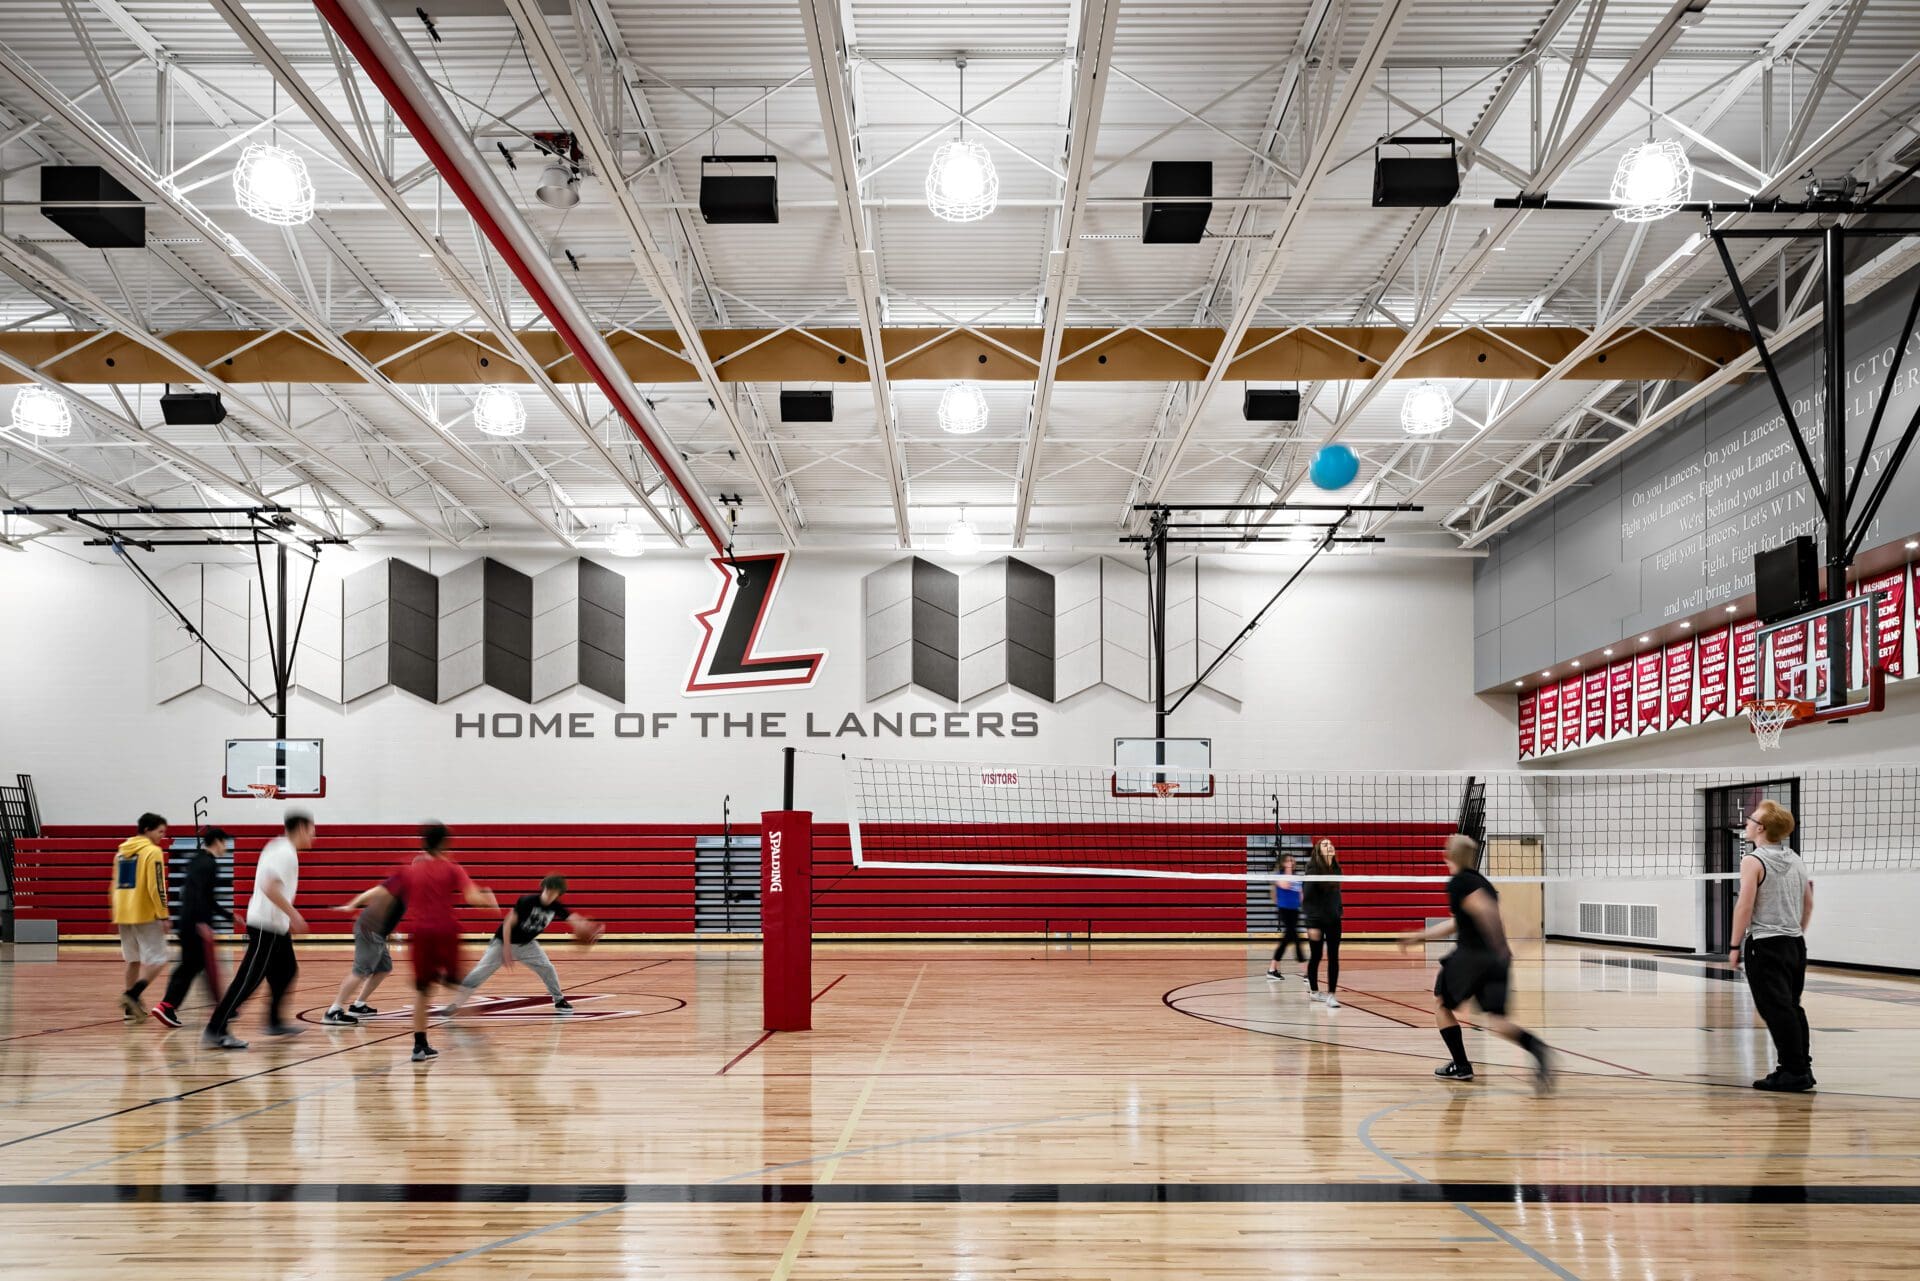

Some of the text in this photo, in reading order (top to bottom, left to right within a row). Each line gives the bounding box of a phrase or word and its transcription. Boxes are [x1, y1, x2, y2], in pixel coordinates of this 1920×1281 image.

[1632, 492, 1645, 508] On
[1647, 483, 1662, 504] you
[1703, 451, 1719, 468] On
[1721, 439, 1740, 463] you
[1792, 399, 1811, 418] On
[1846, 330, 1920, 390] ICTO
[1621, 518, 1641, 539] Fight
[1643, 511, 1658, 531] you
[1699, 474, 1723, 498] Fight
[1726, 464, 1745, 488] you
[1800, 419, 1825, 445] Figh
[1855, 367, 1920, 417] LIER
[1680, 512, 1705, 533] We're
[1706, 490, 1740, 521] behind
[1743, 483, 1762, 508] you
[1765, 470, 1779, 492] all
[1783, 461, 1797, 483] of
[1656, 548, 1677, 571] Fight
[1679, 543, 1696, 564] you
[1743, 507, 1768, 531] Let's
[1771, 487, 1808, 518] WIN
[1732, 541, 1758, 564] Fight
[1760, 533, 1777, 553] for
[1664, 597, 1680, 617] and
[1682, 589, 1703, 610] we'll
[1706, 581, 1732, 601] bring
[1863, 573, 1903, 594] WASHINGTON
[1742, 632, 1756, 643] STAT
[1878, 644, 1896, 658] ERTY
[1739, 685, 1756, 697] LIBERT
[455, 712, 1039, 738] HOME OF THE LANCERS
[981, 773, 1018, 785] VISITORS
[769, 831, 783, 893] SPALDING
